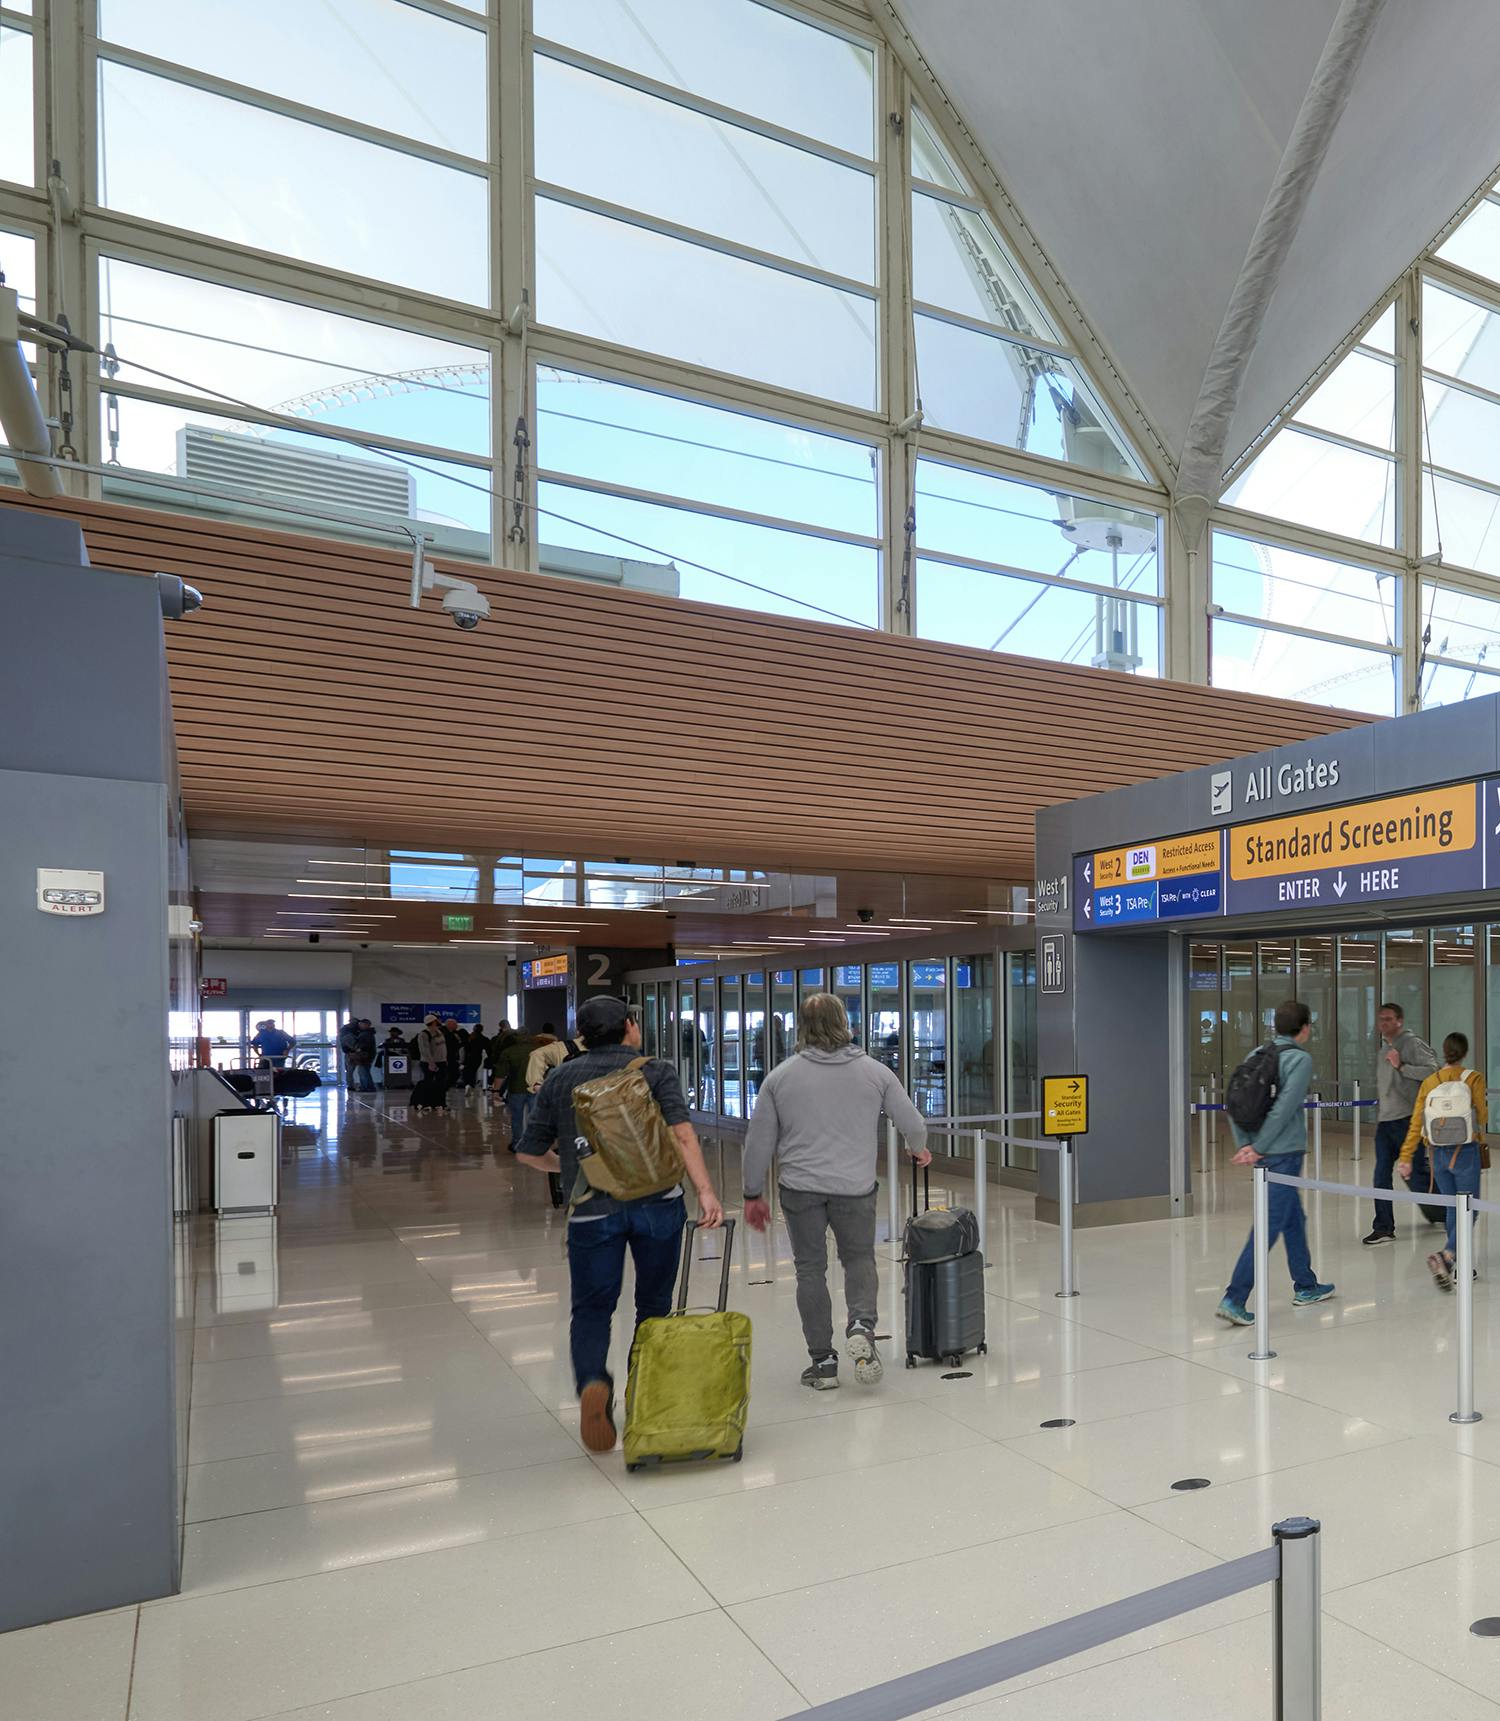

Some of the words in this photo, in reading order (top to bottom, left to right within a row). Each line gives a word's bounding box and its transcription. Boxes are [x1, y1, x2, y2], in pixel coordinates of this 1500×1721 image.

[1245, 766, 1271, 803] All
[1277, 758, 1339, 796] Gates
[1246, 821, 1333, 865] Standard
[1339, 806, 1453, 848] Screening
[1133, 850, 1149, 866] DEN
[1162, 843, 1193, 859] Restricted
[1193, 842, 1215, 854] Access
[1100, 858, 1114, 871] West
[1115, 857, 1121, 878] 2
[1038, 878, 1059, 897] West
[1061, 876, 1068, 909] 1
[1200, 889, 1217, 898] CLEAR
[1278, 878, 1321, 902] ENTER
[1360, 868, 1400, 893] HERE
[51, 904, 94, 912] ALERT
[1038, 900, 1059, 914] Security
[1099, 896, 1114, 907] West
[1115, 894, 1122, 915] 3
[1126, 897, 1138, 910] TSA
[587, 953, 612, 986] 2
[1054, 1100, 1082, 1109] Security
